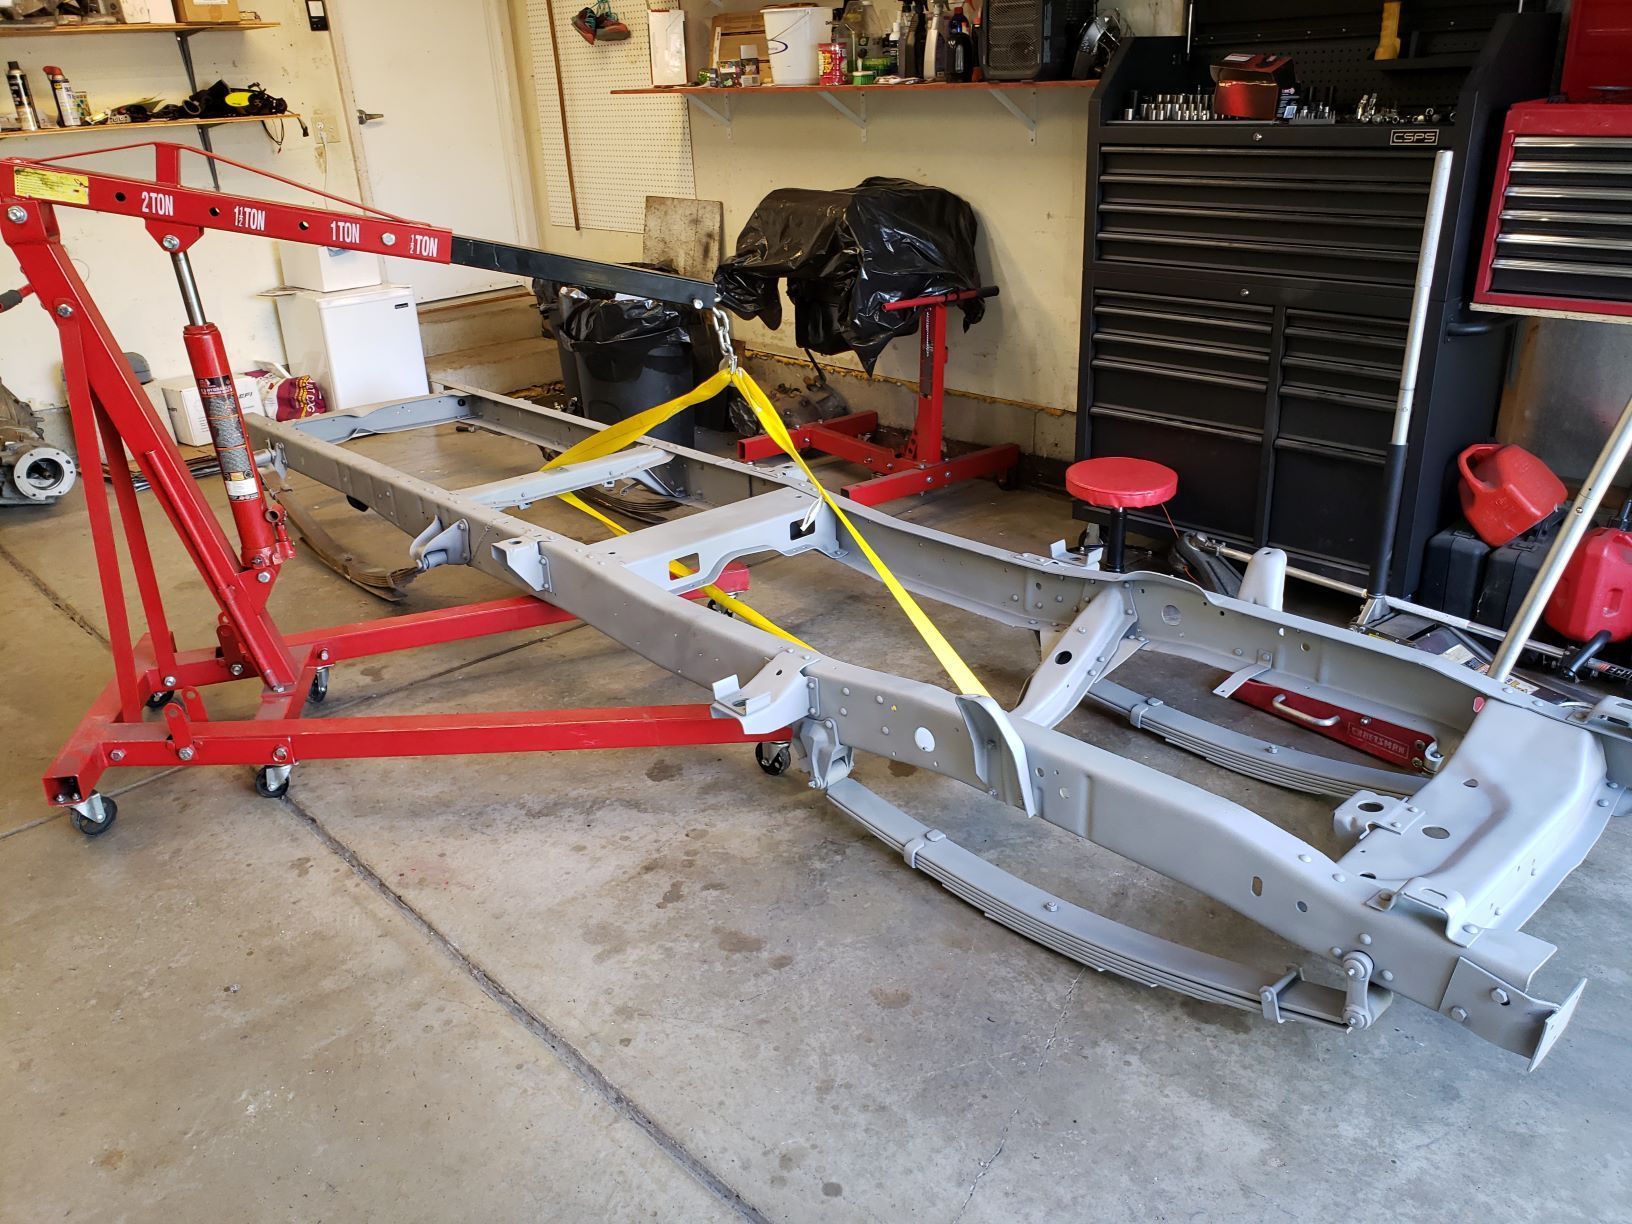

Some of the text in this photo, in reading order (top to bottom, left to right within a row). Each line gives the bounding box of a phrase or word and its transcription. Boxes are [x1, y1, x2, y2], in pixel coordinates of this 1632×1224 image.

[1392, 132, 1436, 144] CSPS
[141, 191, 174, 217] 2 TON
[244, 207, 266, 231] TON
[337, 221, 360, 244] TON
[415, 234, 438, 257] TON
